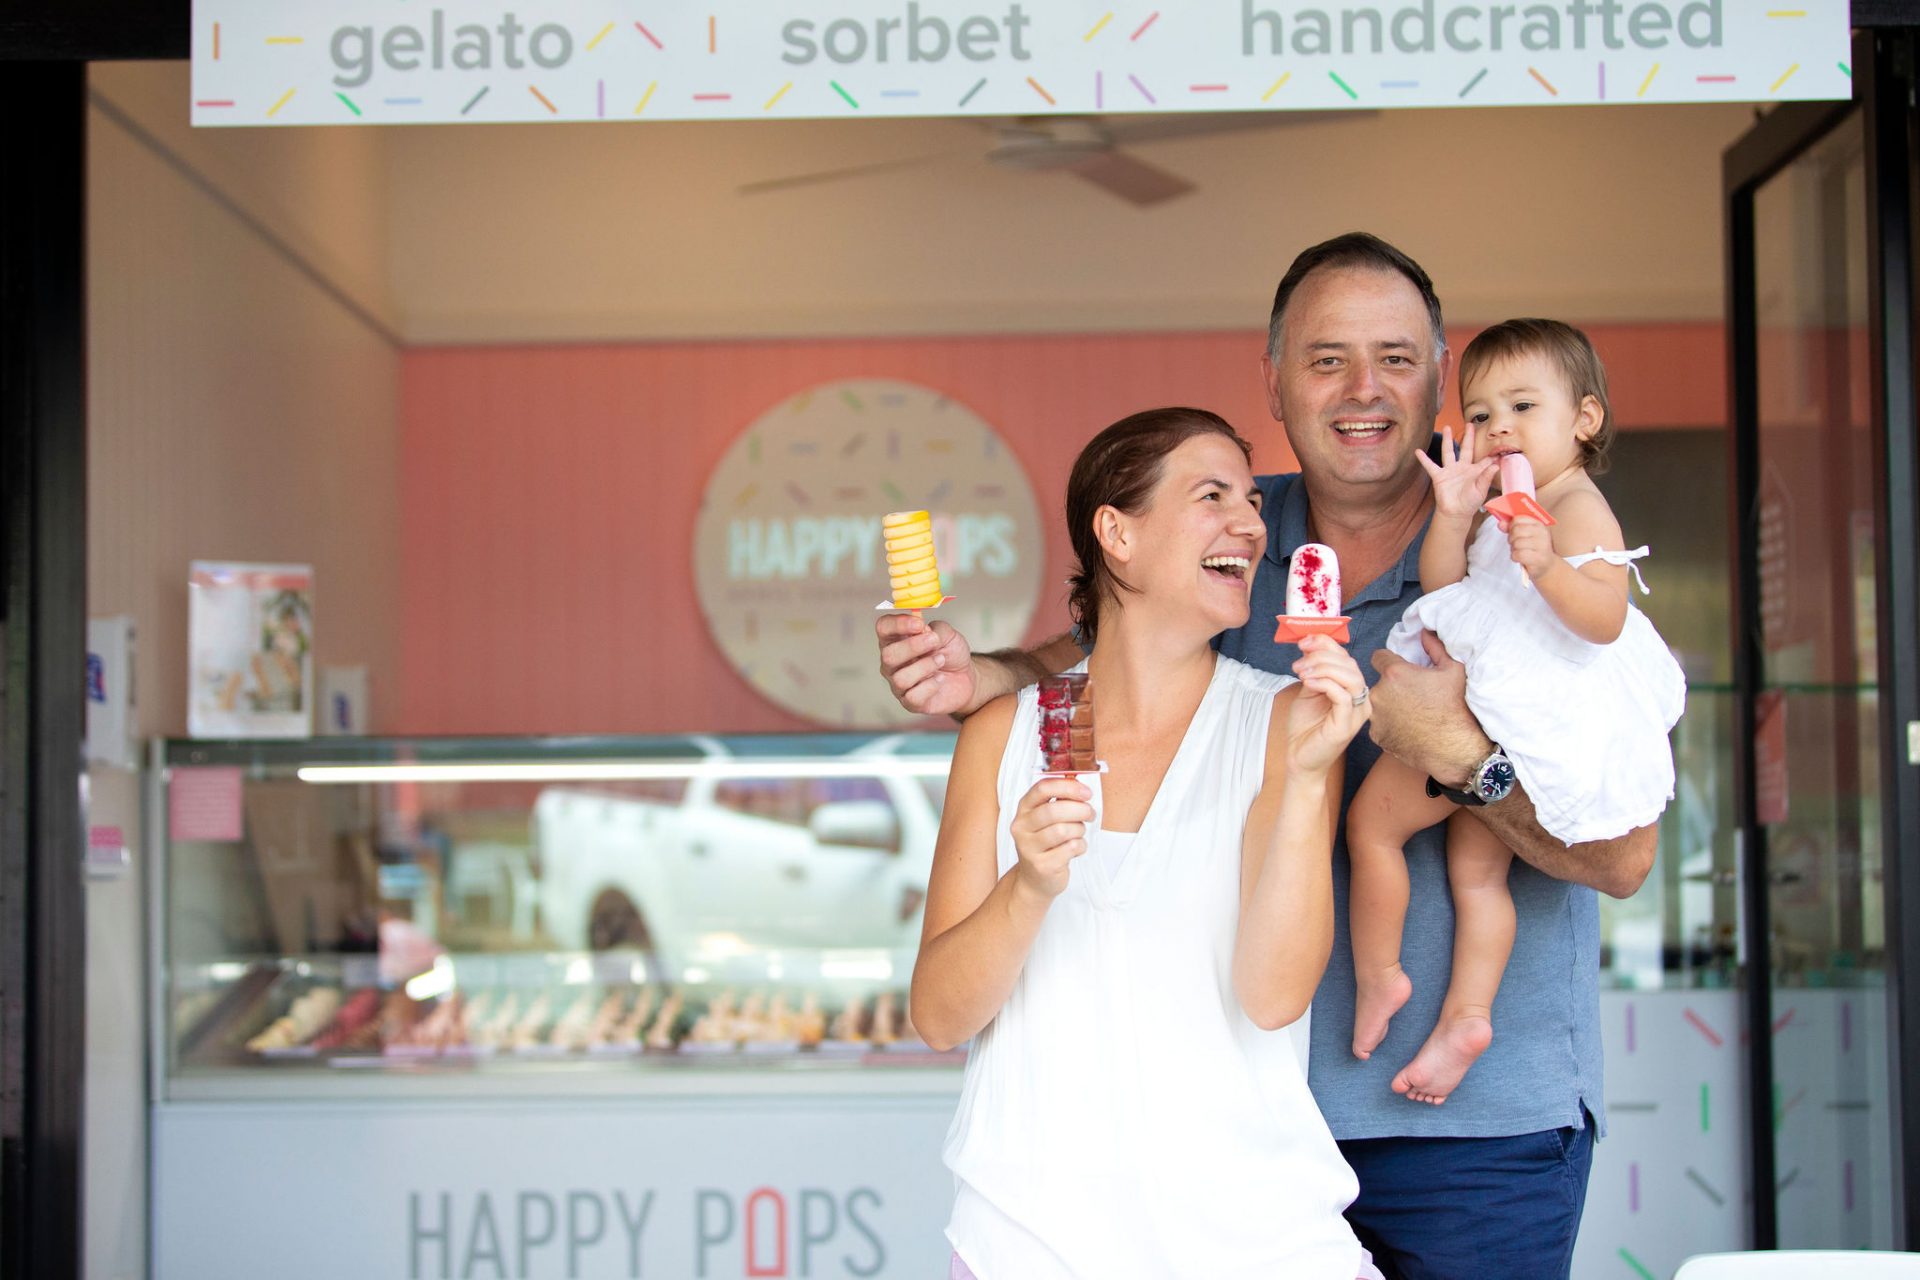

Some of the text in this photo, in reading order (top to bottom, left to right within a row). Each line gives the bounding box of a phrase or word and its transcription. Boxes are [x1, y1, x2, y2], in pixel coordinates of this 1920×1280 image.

[329, 0, 1724, 88] gelato sorbet handcrafted
[728, 514, 1016, 578] HAPPY OPS
[407, 1186, 886, 1280] HAPPY POPS
